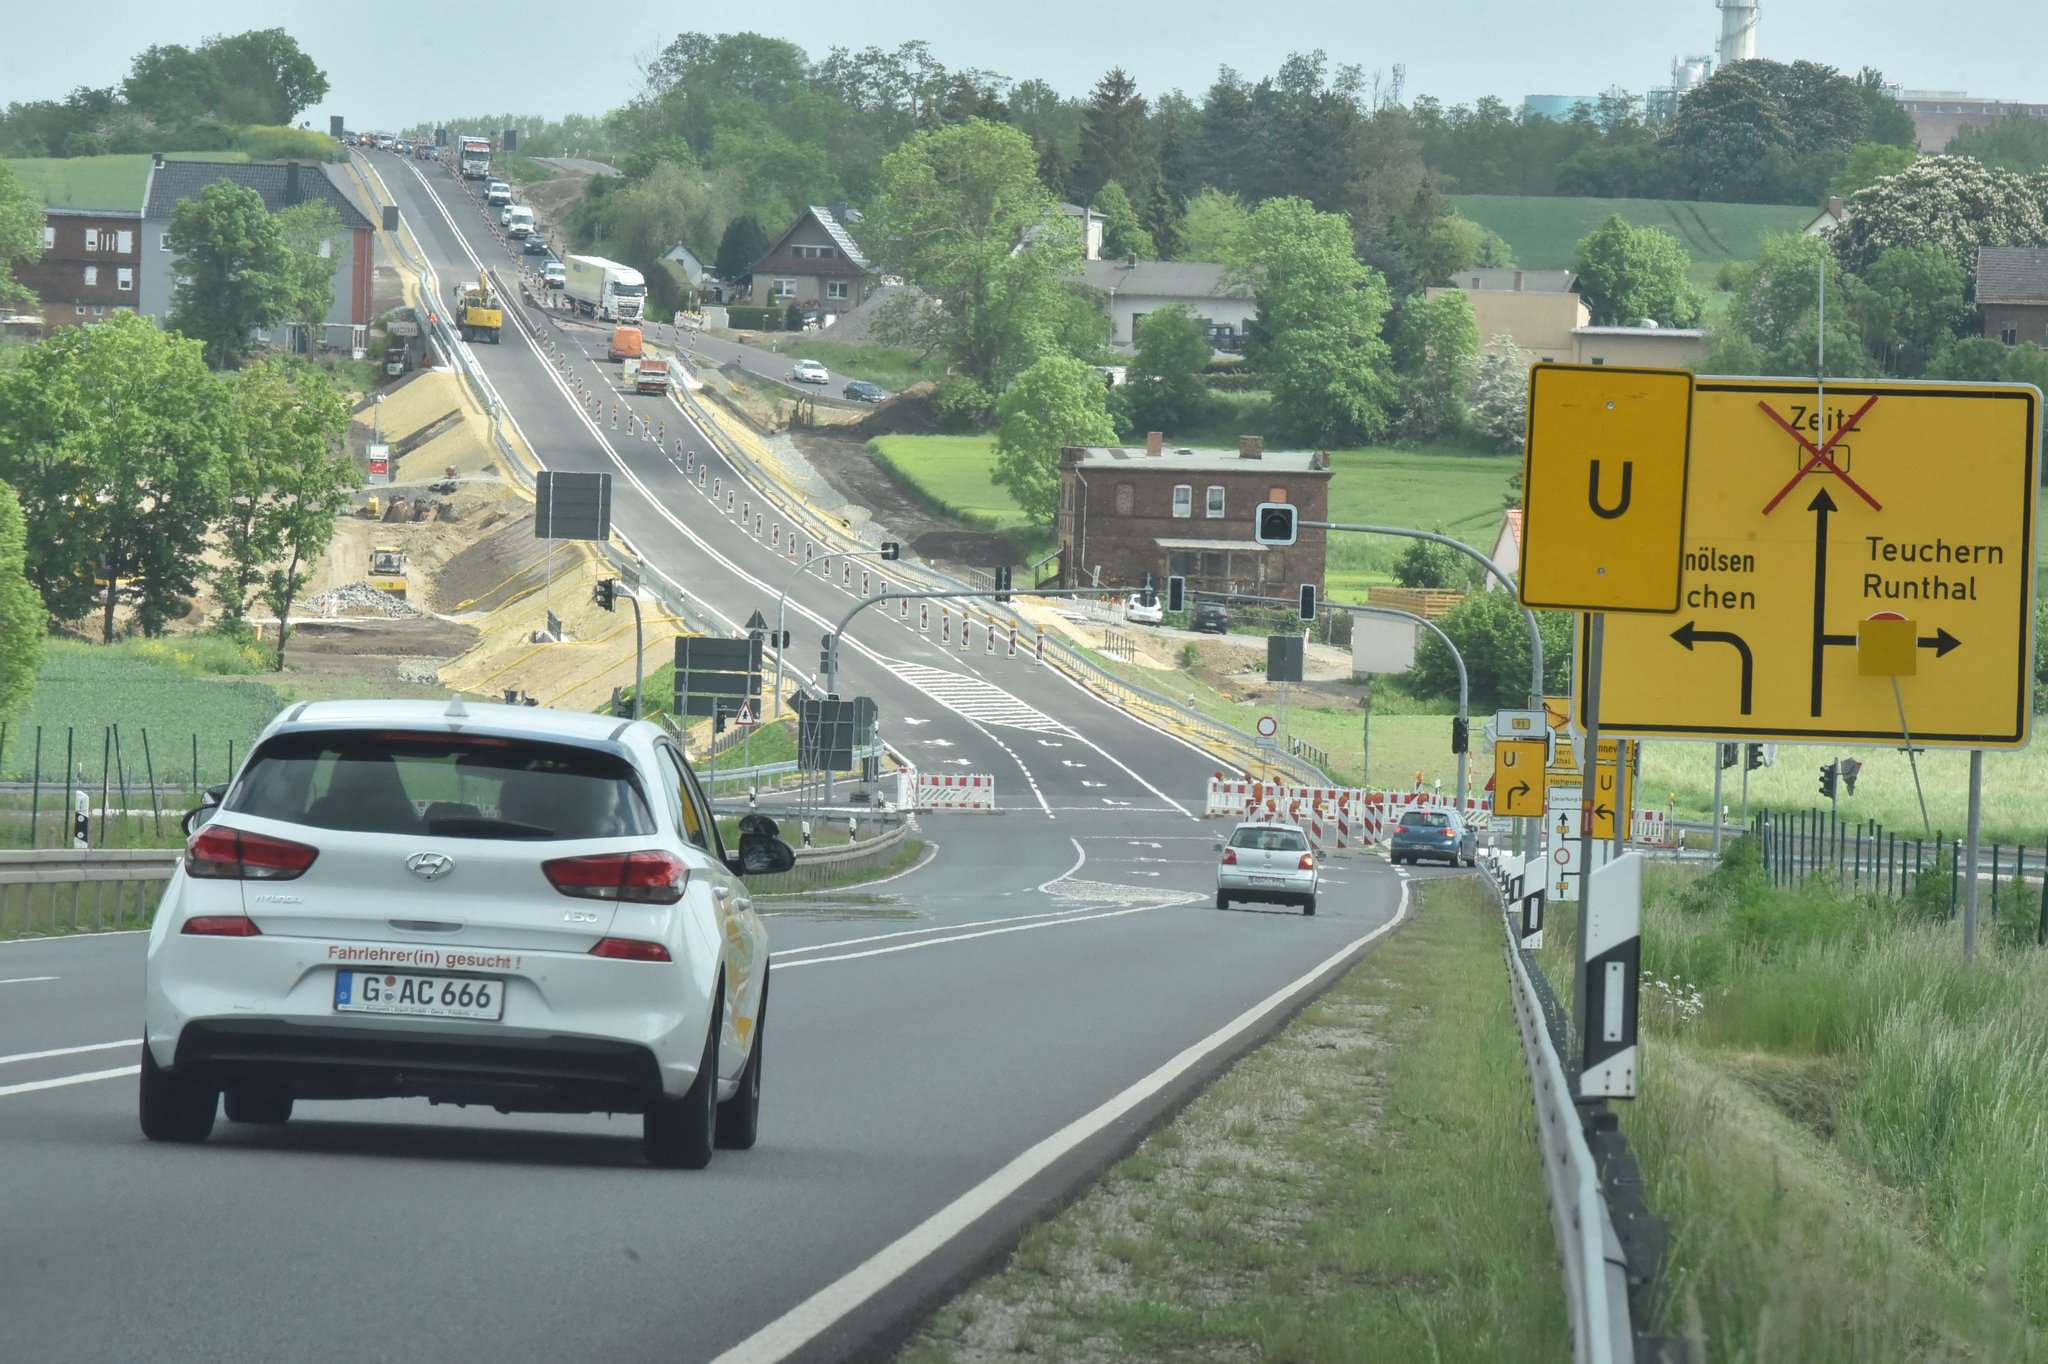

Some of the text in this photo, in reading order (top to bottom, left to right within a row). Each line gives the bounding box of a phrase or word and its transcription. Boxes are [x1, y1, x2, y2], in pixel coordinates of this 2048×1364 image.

[1588, 459, 1633, 520] U
[1865, 536, 2004, 565] Teuchern
[1863, 573, 1977, 601] Runthal
[1515, 719, 1526, 728] 91
[1503, 751, 1516, 767] U
[1600, 775, 1613, 791] U
[327, 945, 440, 968] Fahrlehrer(in)
[445, 952, 512, 969] gesucht
[362, 976, 491, 1009] G AC 666
